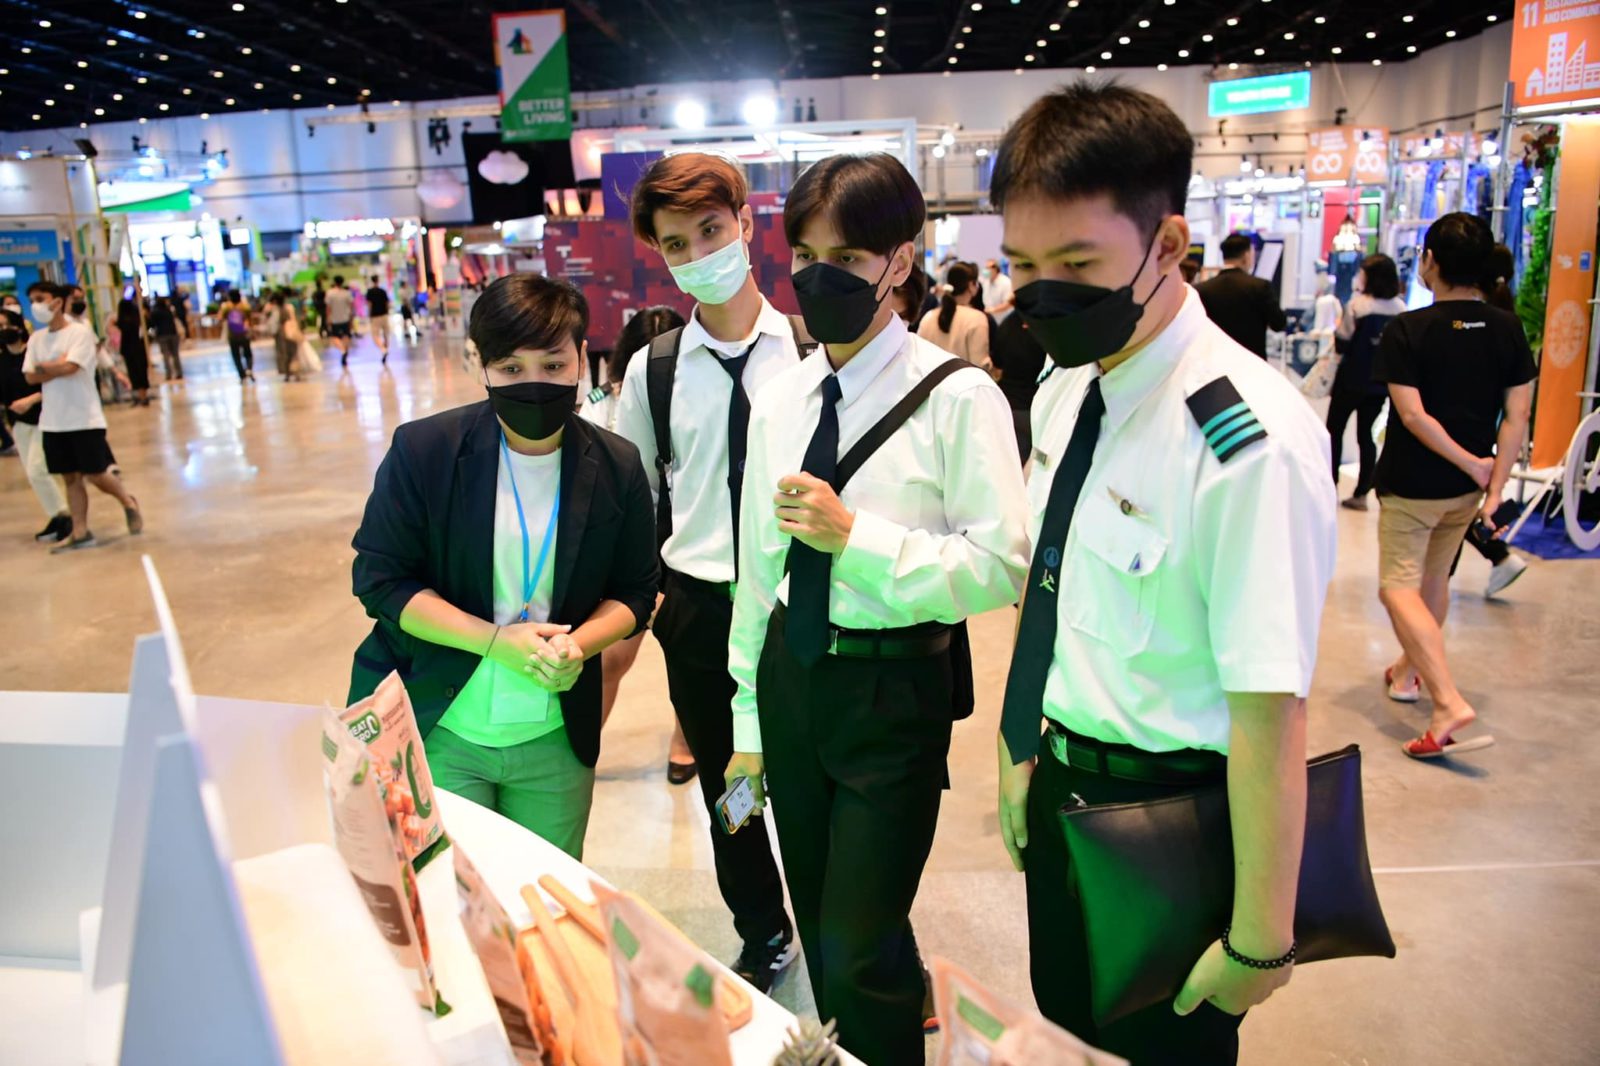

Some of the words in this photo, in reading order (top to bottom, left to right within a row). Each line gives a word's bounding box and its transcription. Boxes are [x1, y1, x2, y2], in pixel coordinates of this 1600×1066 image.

[1522, 1, 1540, 28] 11
[1543, 10, 1560, 24] AND
[518, 98, 565, 112] BETTER
[523, 111, 566, 125] LIVING
